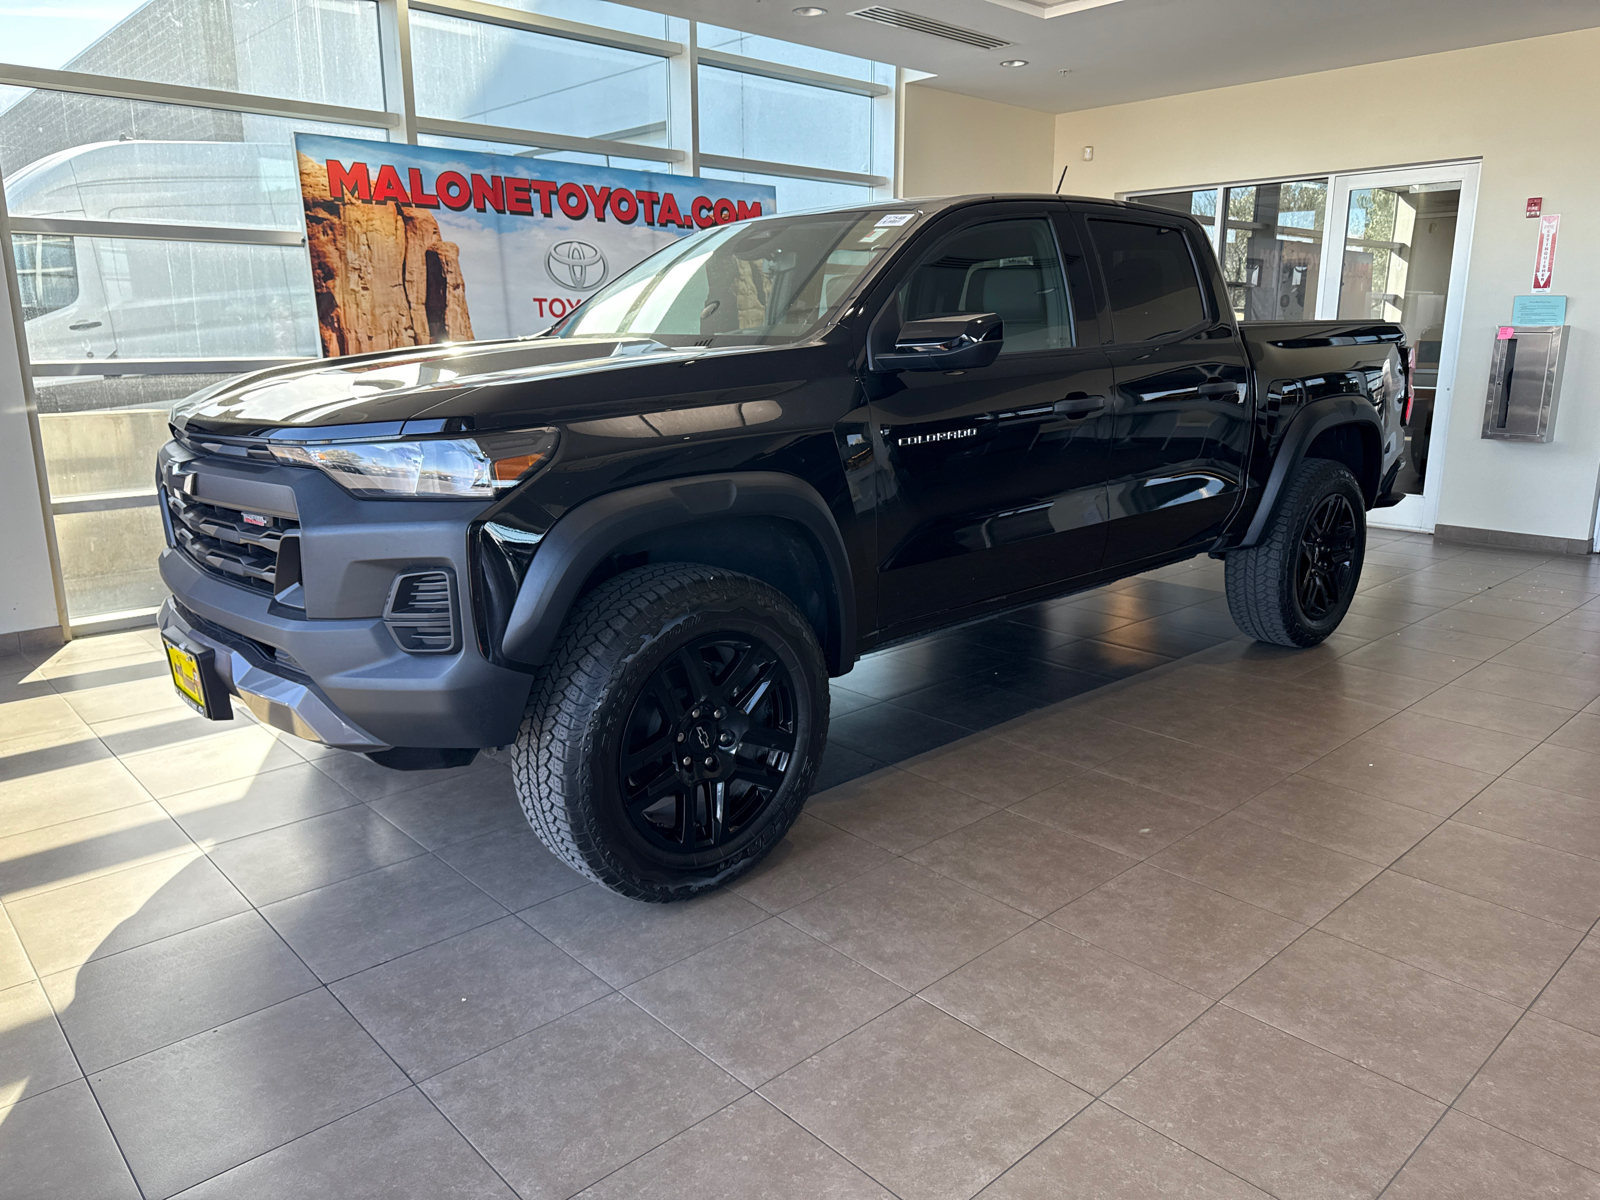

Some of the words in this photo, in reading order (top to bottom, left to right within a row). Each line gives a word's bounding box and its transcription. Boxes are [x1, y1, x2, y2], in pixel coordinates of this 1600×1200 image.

[326, 159, 762, 229] MALONETOYOTA.COM
[1540, 230, 1550, 281] EXTINGUISHER
[533, 297, 582, 319] TOY
[898, 428, 977, 446] COLORADO
